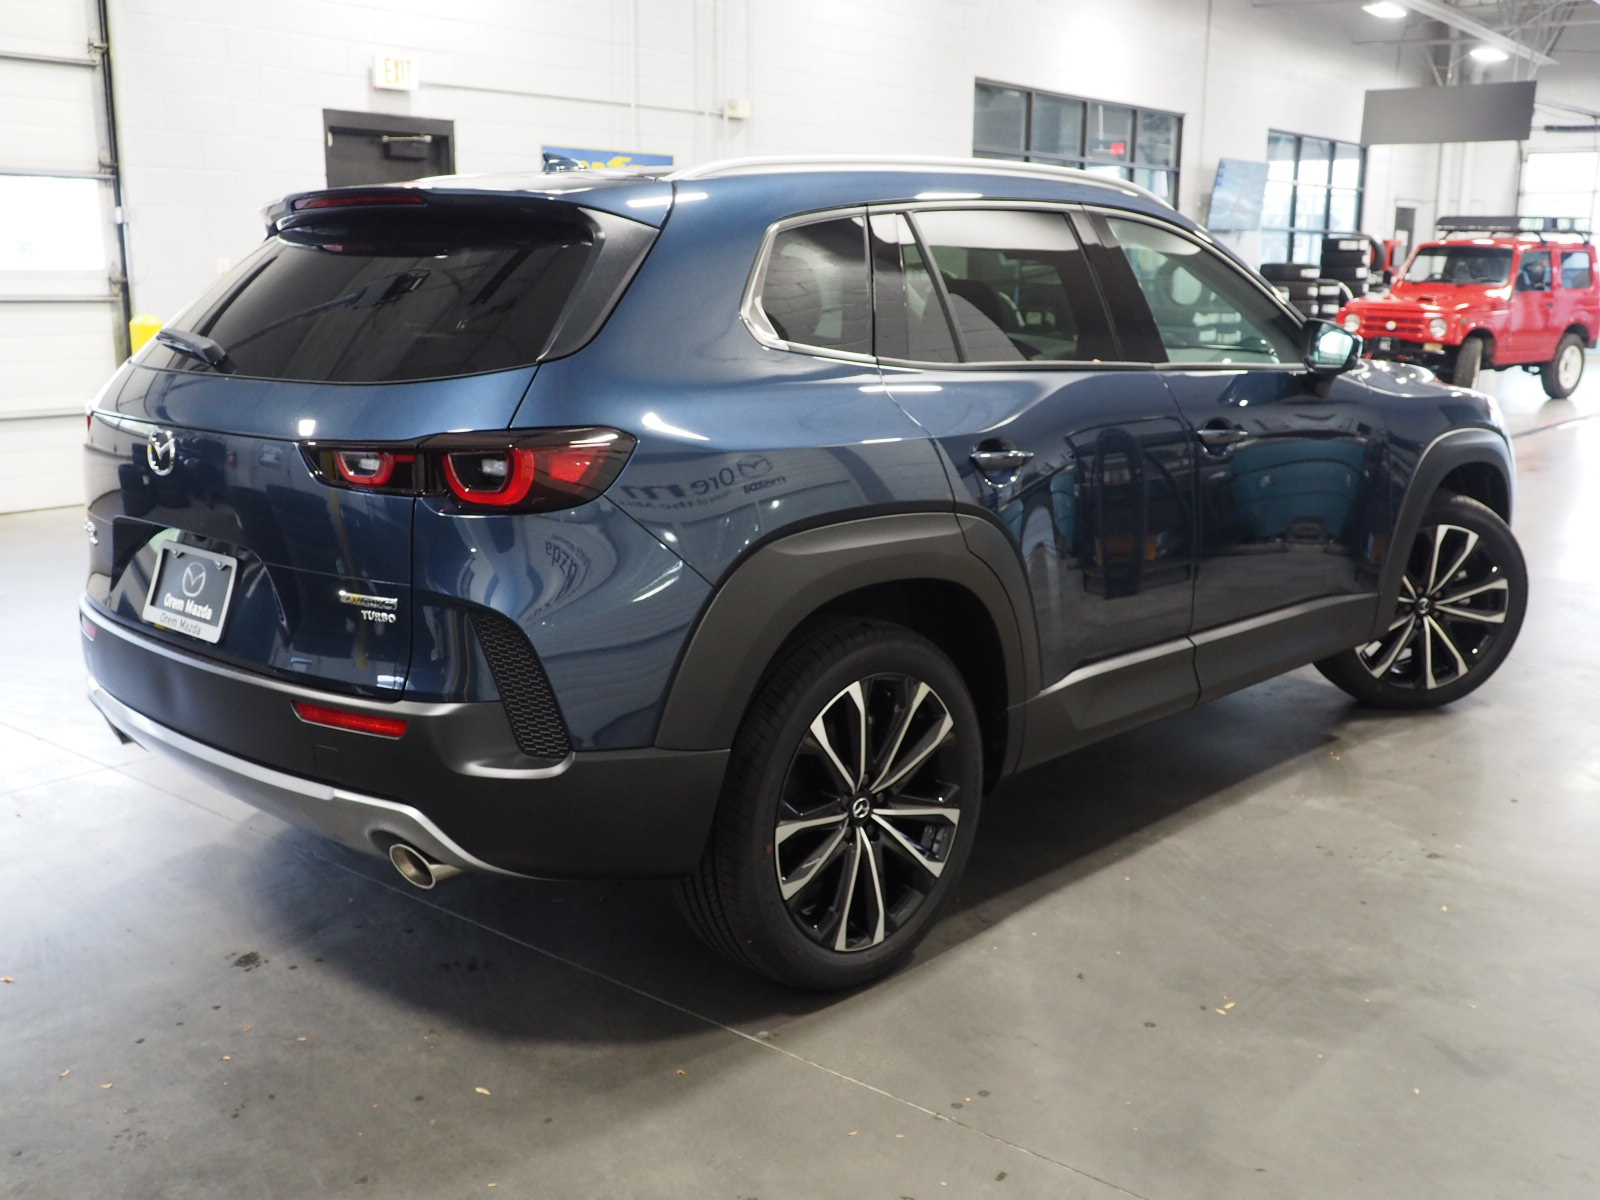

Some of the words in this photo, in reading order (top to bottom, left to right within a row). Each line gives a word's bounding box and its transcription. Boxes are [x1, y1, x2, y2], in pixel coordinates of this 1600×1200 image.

[384, 57, 412, 84] EXIT
[163, 592, 185, 611] Orem
[185, 599, 213, 620] Mazda
[360, 609, 397, 623] TURBO
[159, 612, 178, 627] Orem
[179, 618, 202, 636] Mazda
